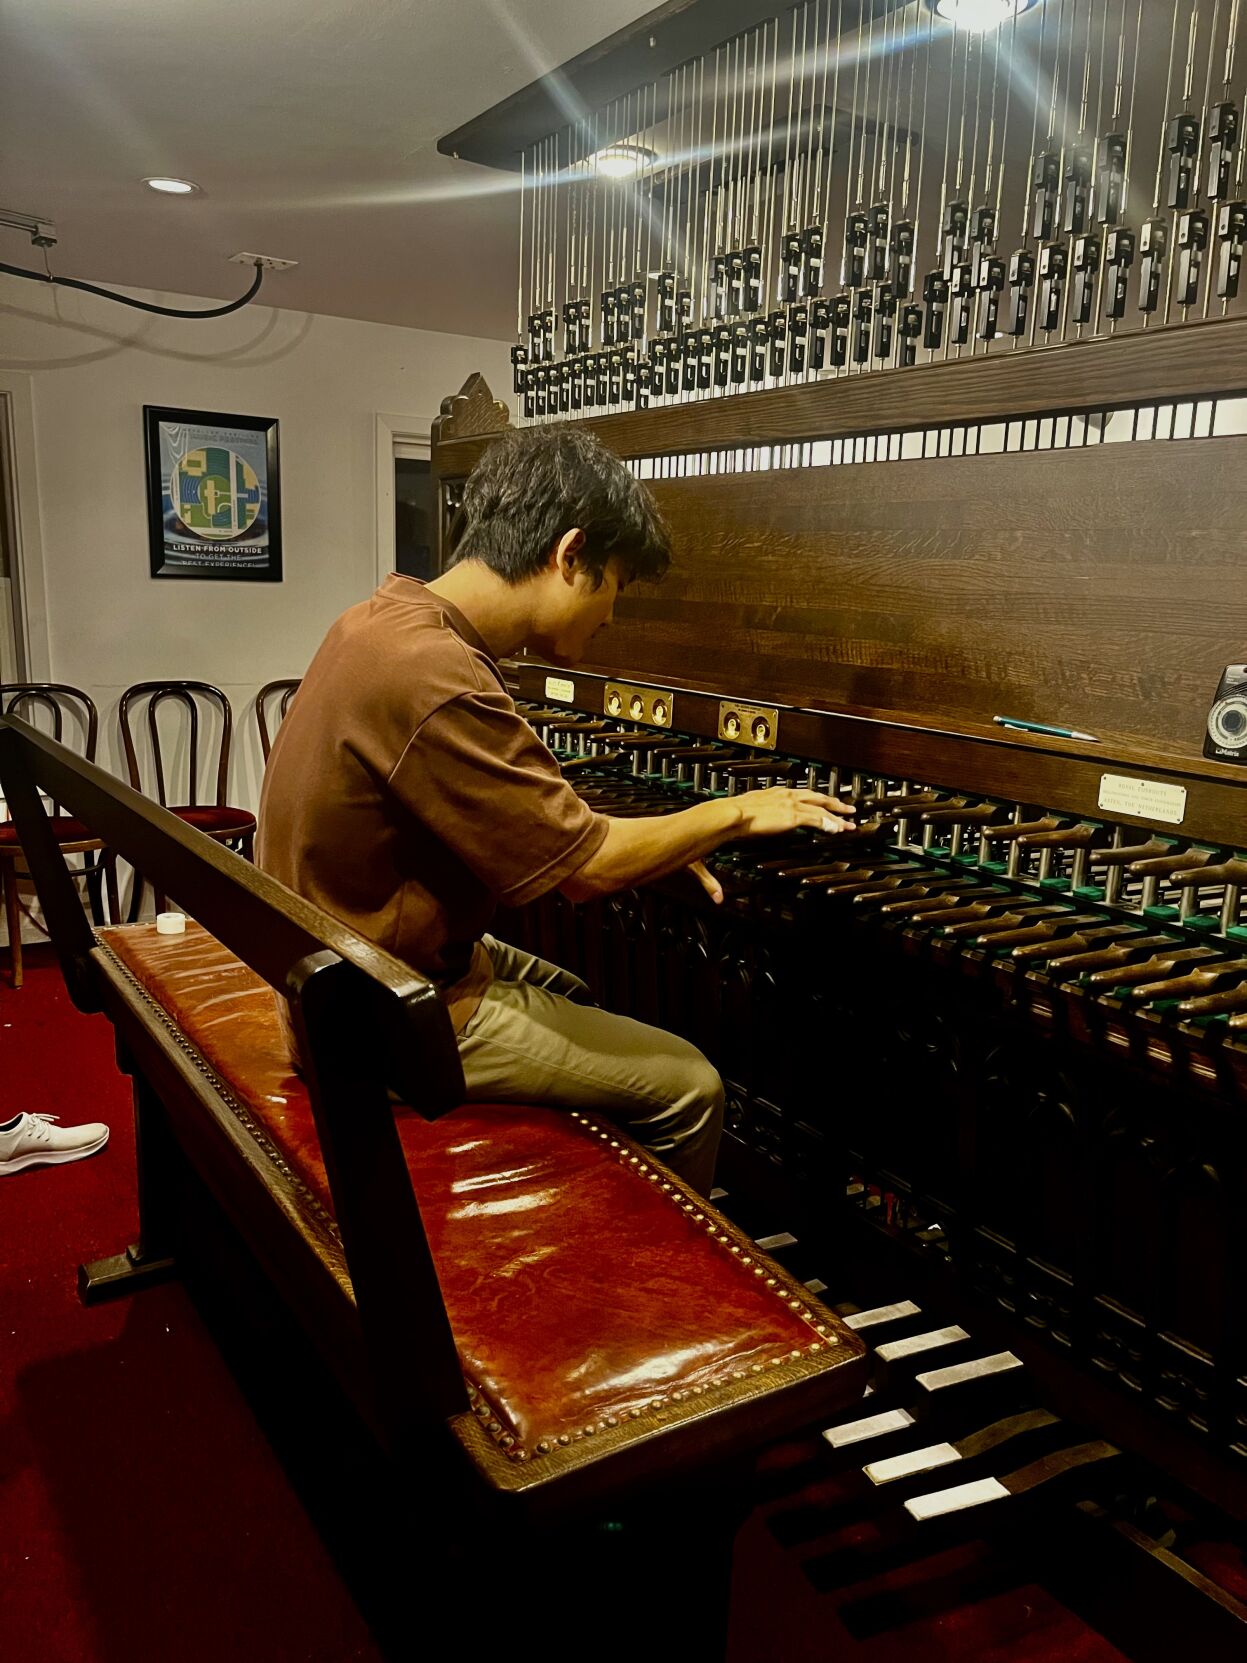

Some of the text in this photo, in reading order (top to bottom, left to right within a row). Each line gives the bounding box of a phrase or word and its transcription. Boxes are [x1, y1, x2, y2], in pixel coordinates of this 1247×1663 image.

[173, 544, 262, 554] LISTEN FROM OUTSIDE
